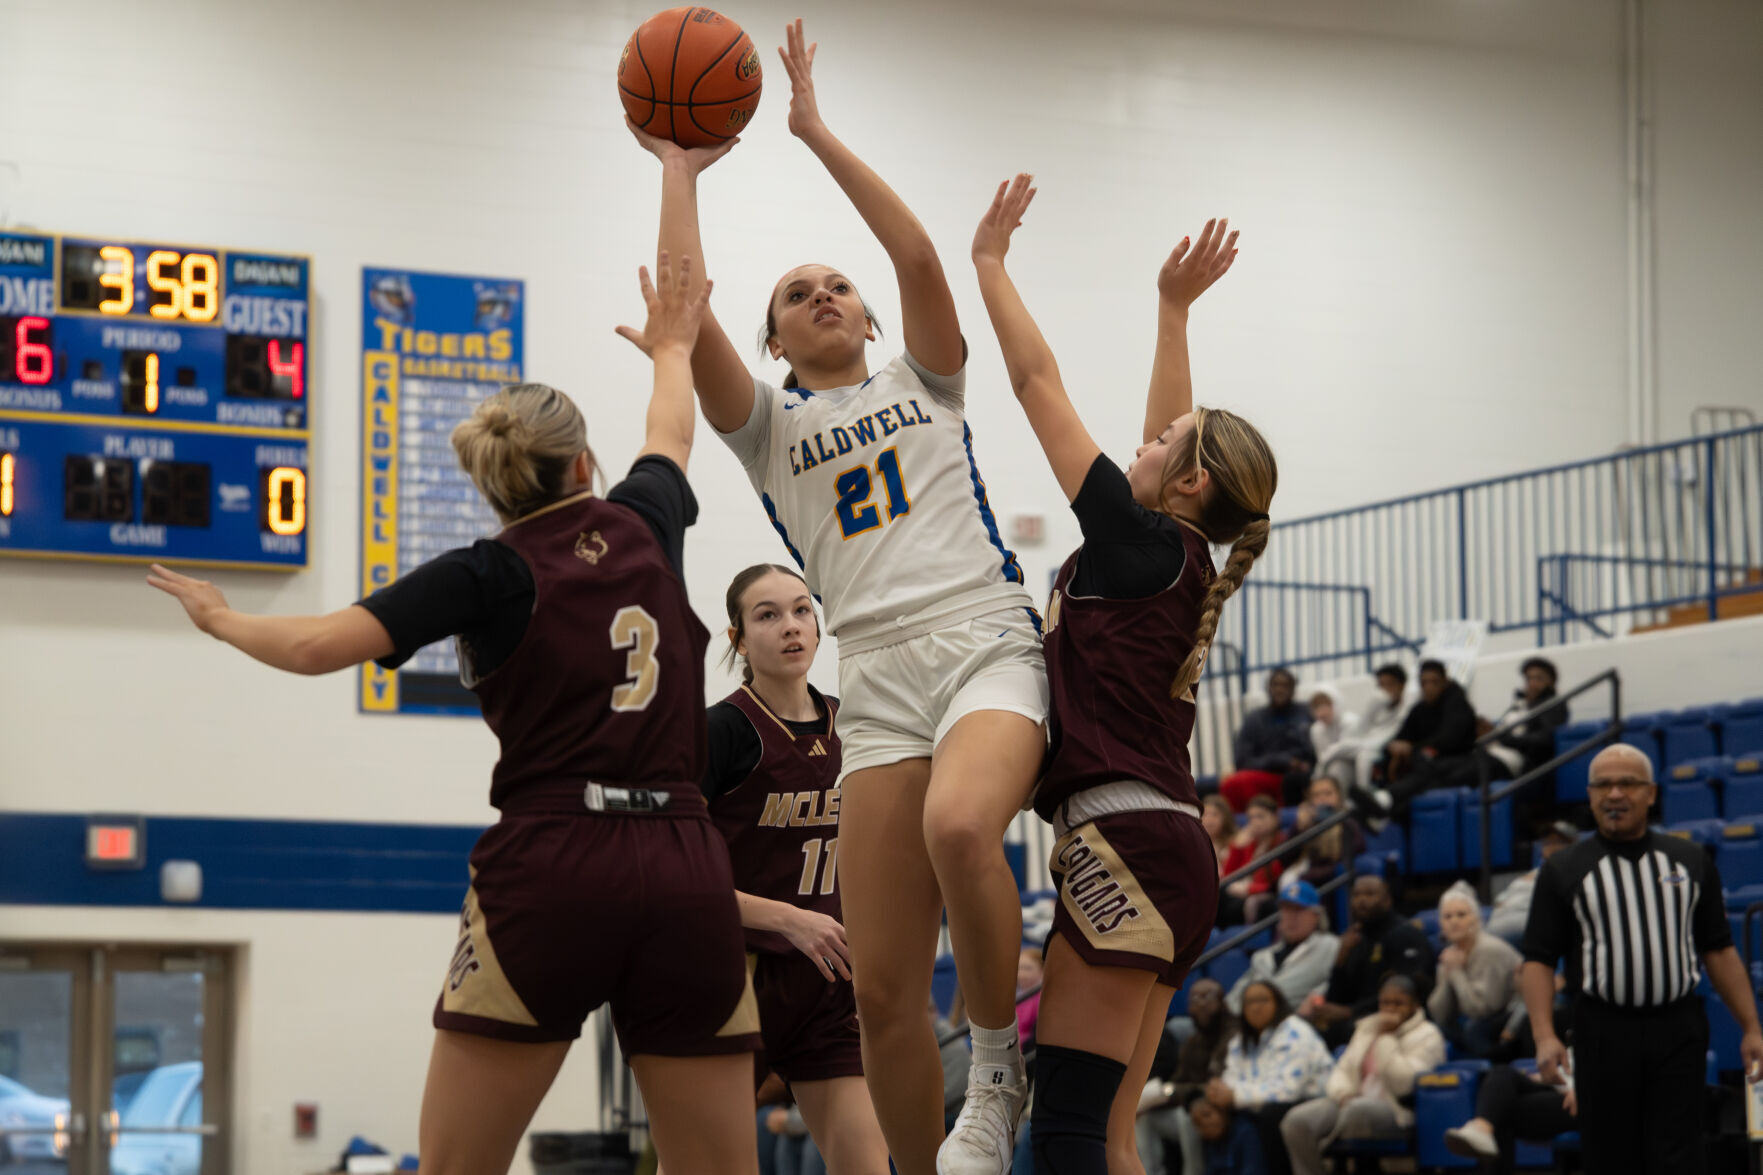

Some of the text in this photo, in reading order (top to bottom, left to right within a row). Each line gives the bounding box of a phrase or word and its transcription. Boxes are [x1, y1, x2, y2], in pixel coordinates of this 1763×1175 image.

[0, 275, 56, 316] OME
[224, 294, 306, 336] GUEST
[16, 316, 53, 385] 6
[102, 327, 182, 352] PERIOD
[268, 339, 304, 398] 4
[374, 317, 512, 361] TIGERS
[145, 353, 159, 413] 1
[371, 362, 392, 543] CALDWELL
[268, 466, 306, 535] 0
[833, 445, 912, 541] 21
[610, 604, 660, 713] 3
[757, 788, 841, 828] MCLE
[797, 838, 839, 895] 11
[1058, 832, 1141, 936] COUGARS
